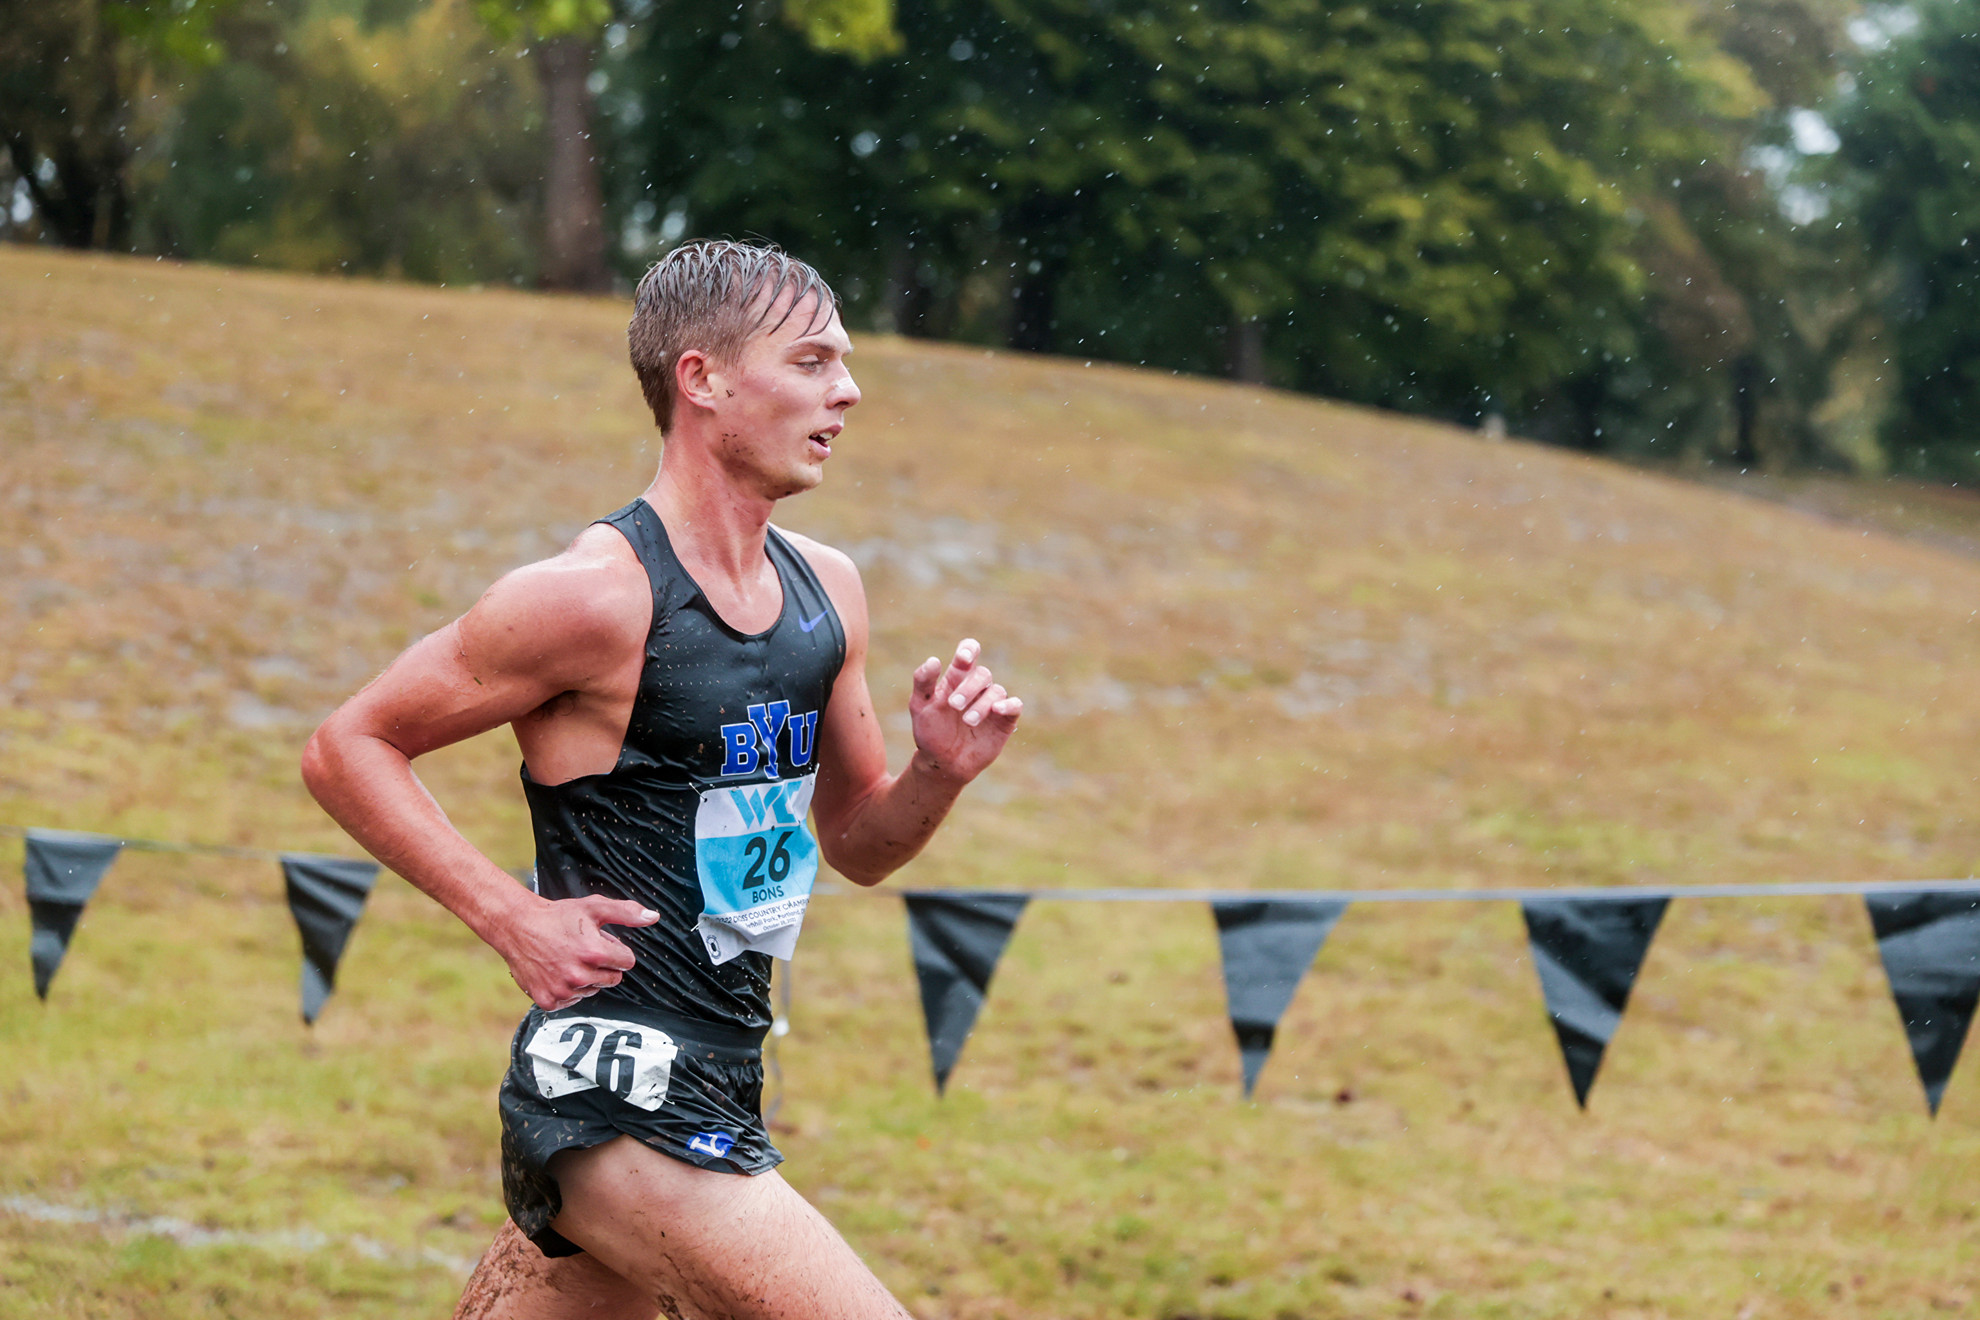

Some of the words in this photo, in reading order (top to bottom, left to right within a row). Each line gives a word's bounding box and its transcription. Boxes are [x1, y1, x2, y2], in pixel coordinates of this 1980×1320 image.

[720, 700, 819, 779] BYU
[742, 831, 795, 891] 26
[748, 905, 781, 920] COUNTRY
[752, 885, 785, 904] BONS
[559, 1023, 643, 1100] 26
